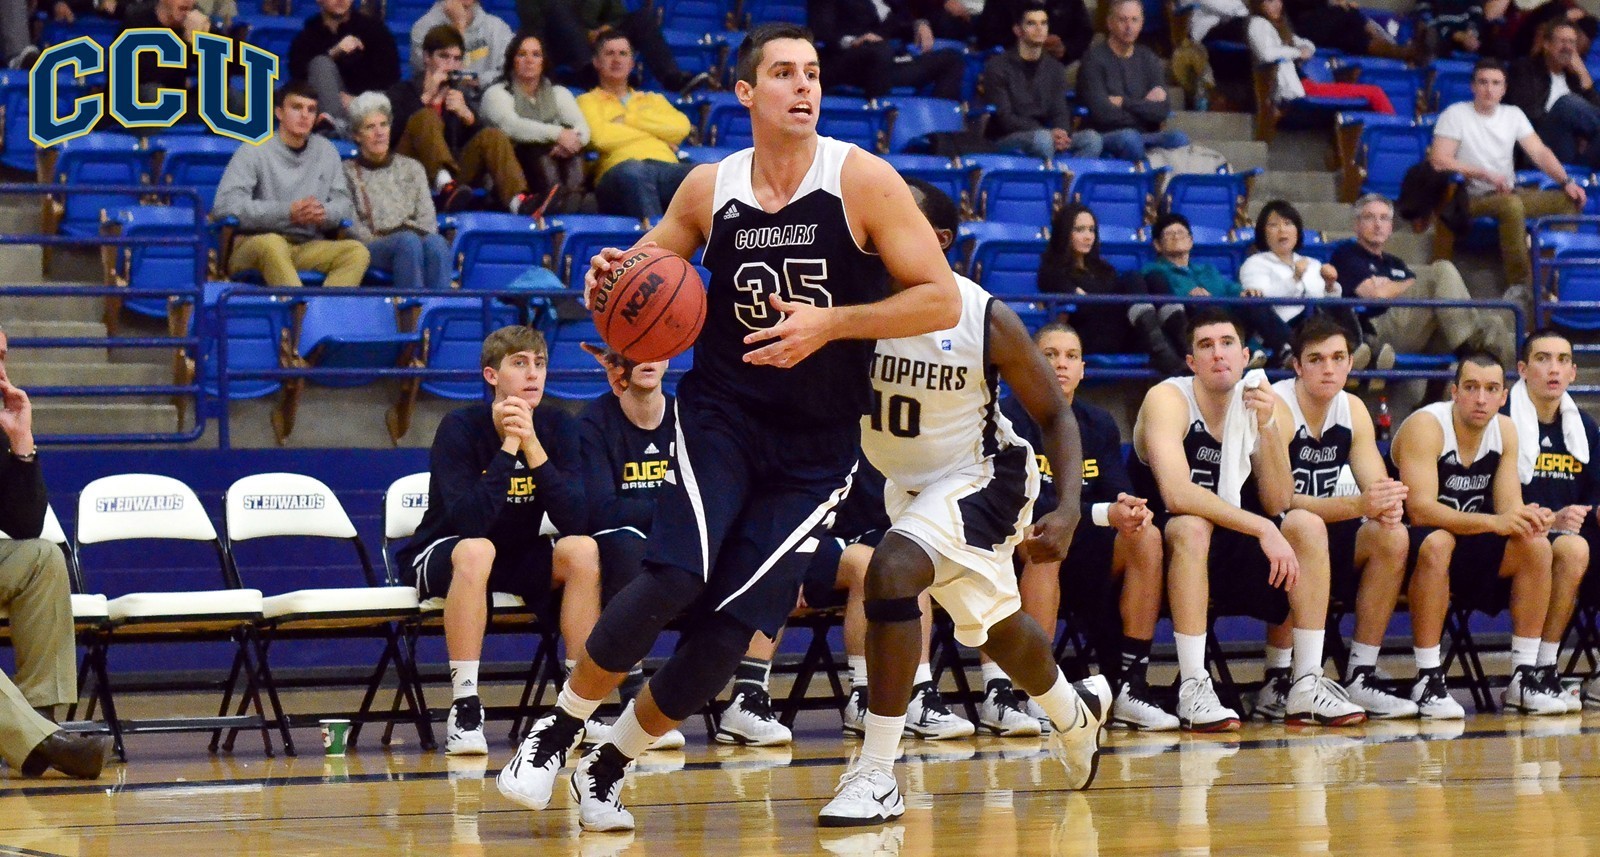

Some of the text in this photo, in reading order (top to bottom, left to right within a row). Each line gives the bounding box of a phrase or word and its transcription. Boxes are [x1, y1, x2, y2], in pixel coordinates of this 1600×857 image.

[735, 223, 818, 250] COUGARS
[593, 252, 651, 314] Wilson
[620, 272, 665, 325] NCAA
[734, 258, 832, 332] 35
[870, 353, 968, 391] TOPPERS
